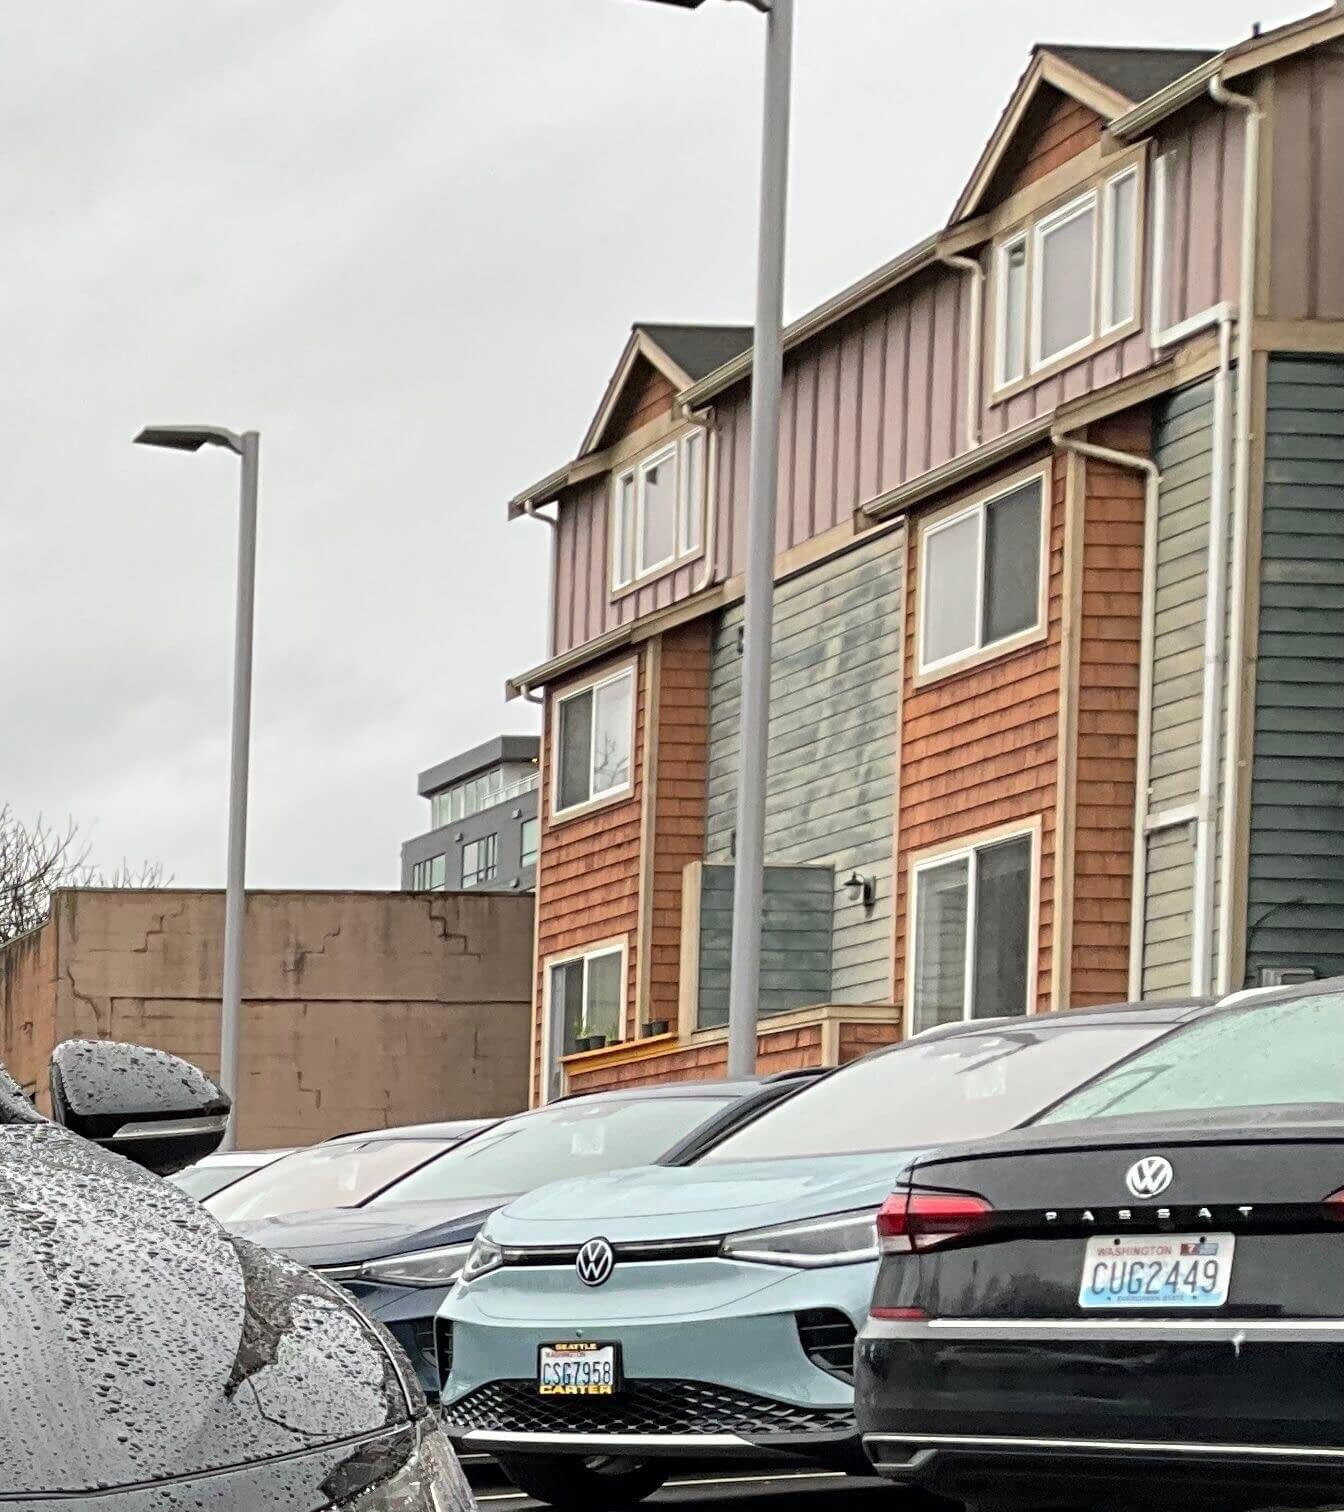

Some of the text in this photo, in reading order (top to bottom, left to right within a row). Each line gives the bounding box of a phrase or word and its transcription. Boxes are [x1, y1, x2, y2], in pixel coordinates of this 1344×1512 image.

[1126, 1156, 1173, 1199] VW
[1045, 1206, 1254, 1222] PASSAT
[576, 1239, 613, 1286] VW
[1097, 1245, 1172, 1257] WASHINGTON
[1091, 1260, 1219, 1295] CUG2449
[543, 1361, 611, 1385] CSG7958
[539, 1385, 612, 1395] CARTER
